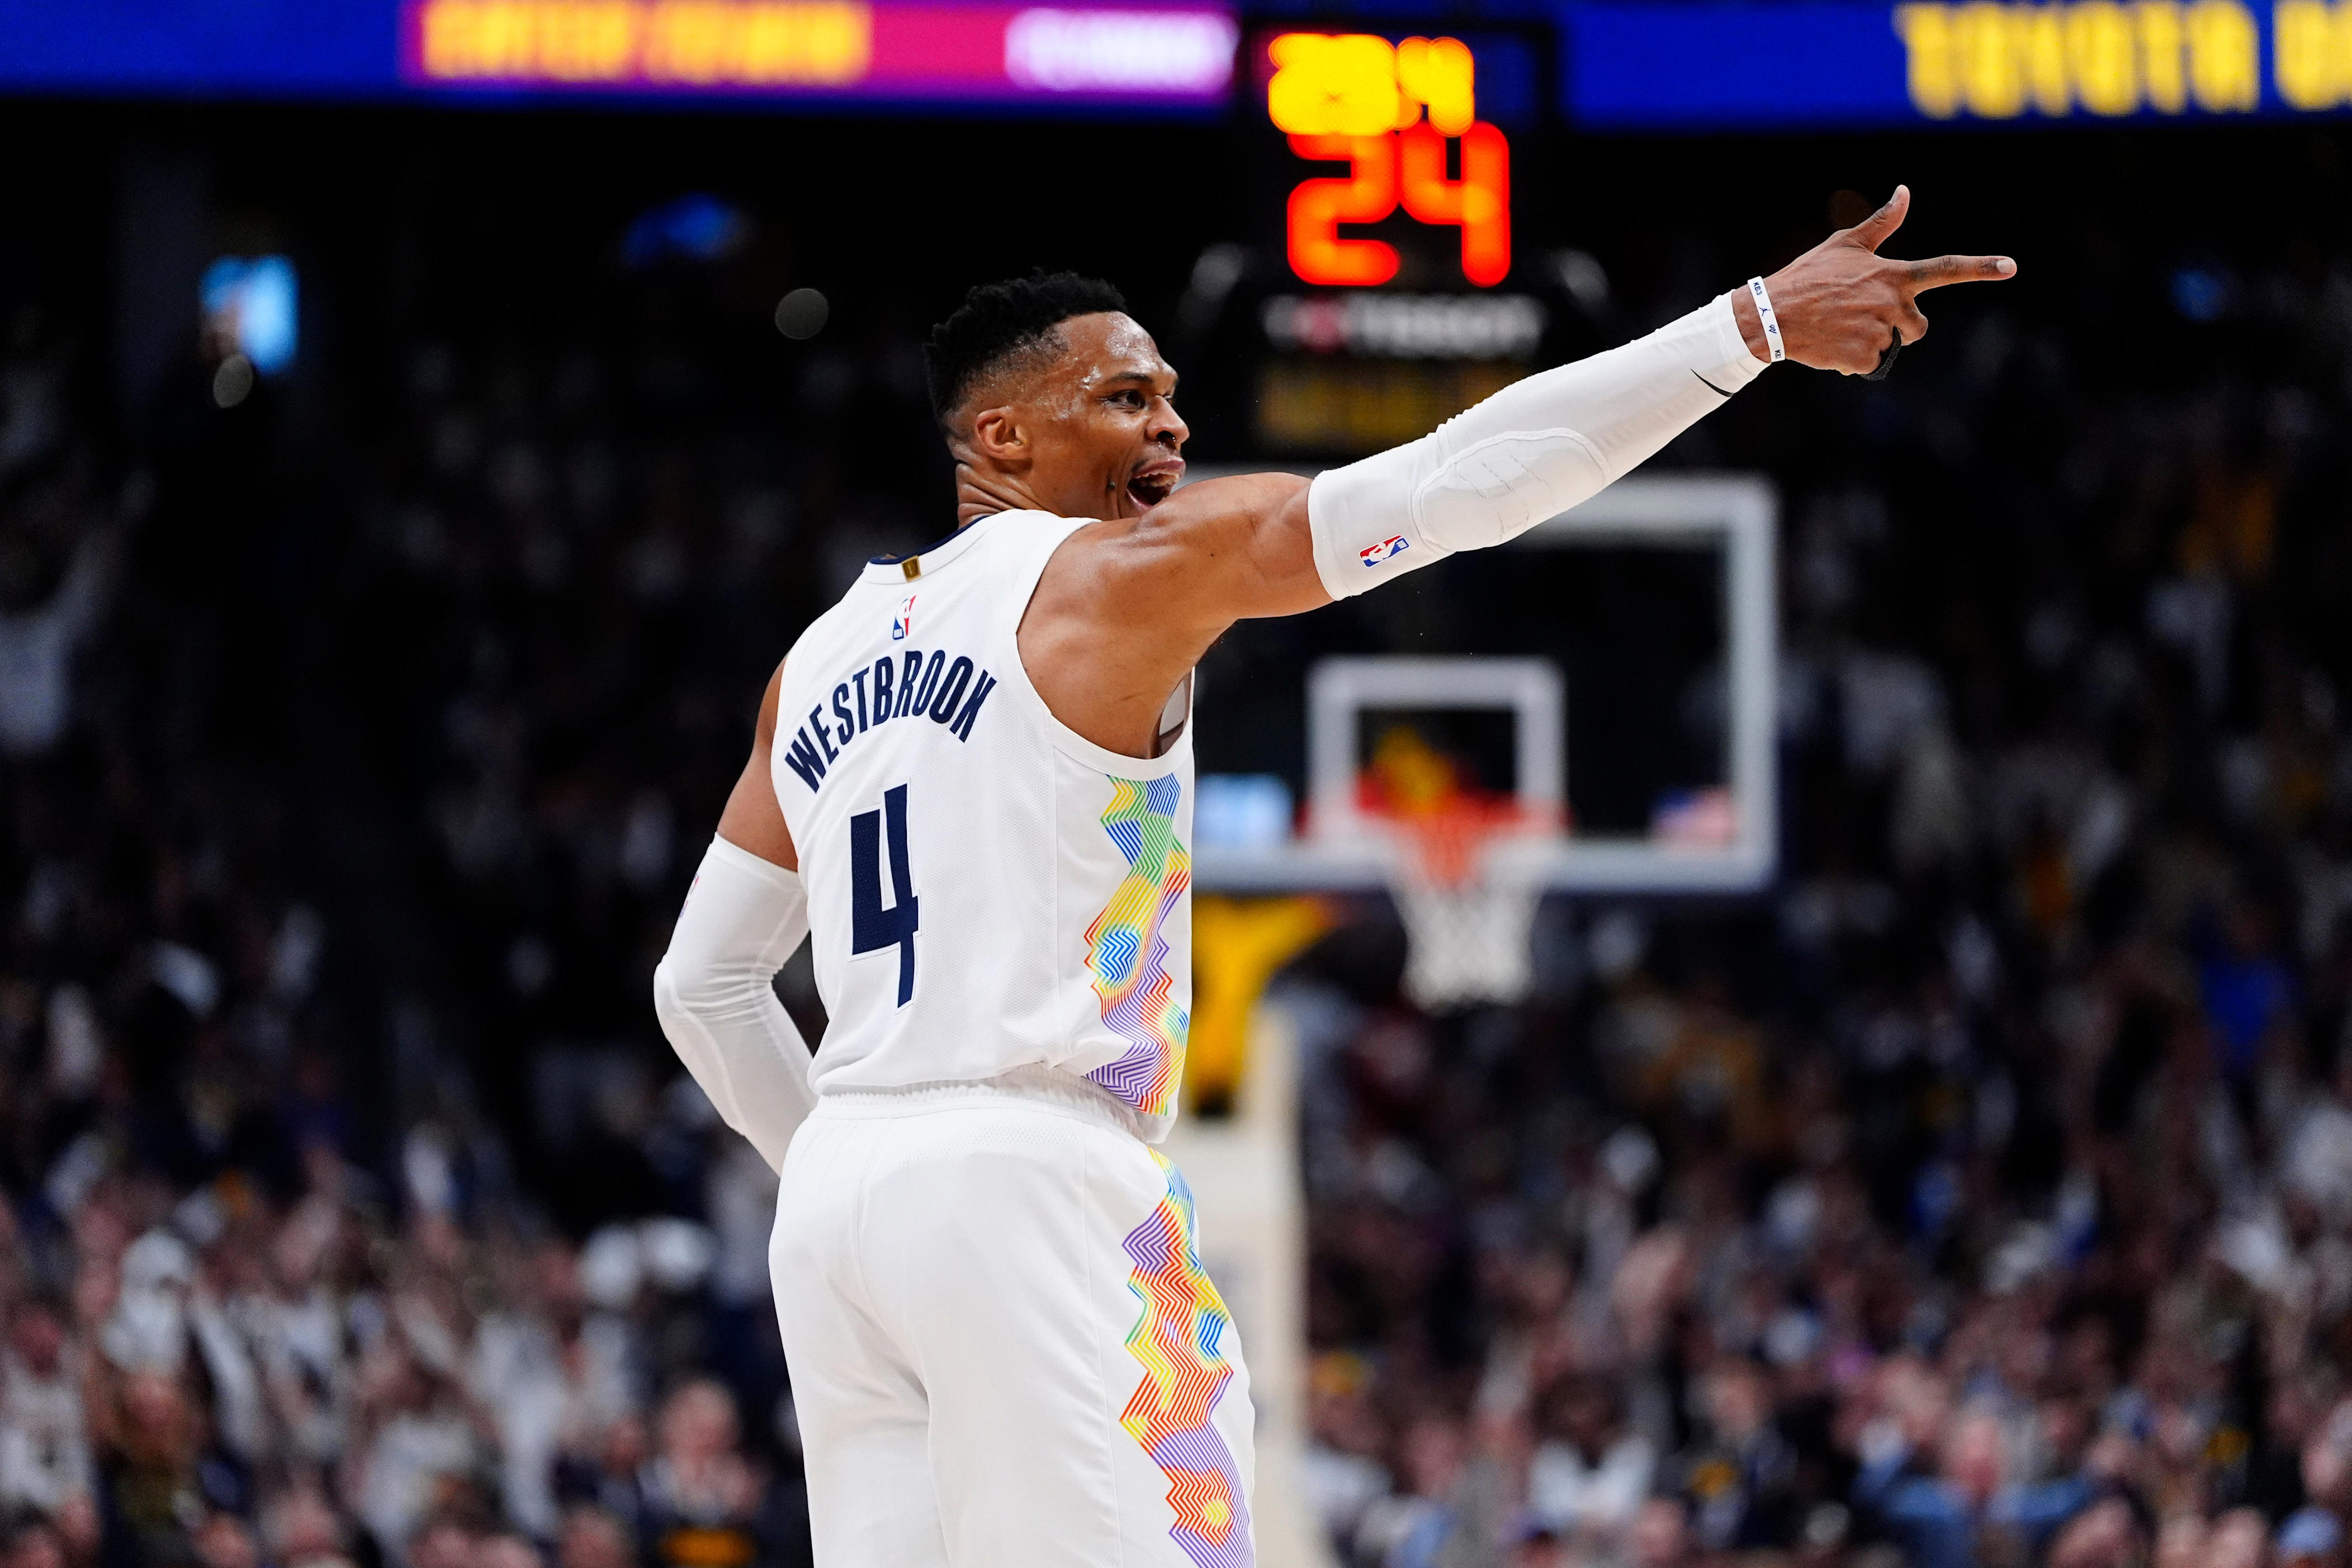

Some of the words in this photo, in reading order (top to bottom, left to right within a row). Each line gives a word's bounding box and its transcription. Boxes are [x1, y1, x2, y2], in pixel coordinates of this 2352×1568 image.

[1287, 121, 1511, 287] 24
[785, 650, 996, 793] WESTBROOK
[850, 783, 919, 1008] 4
